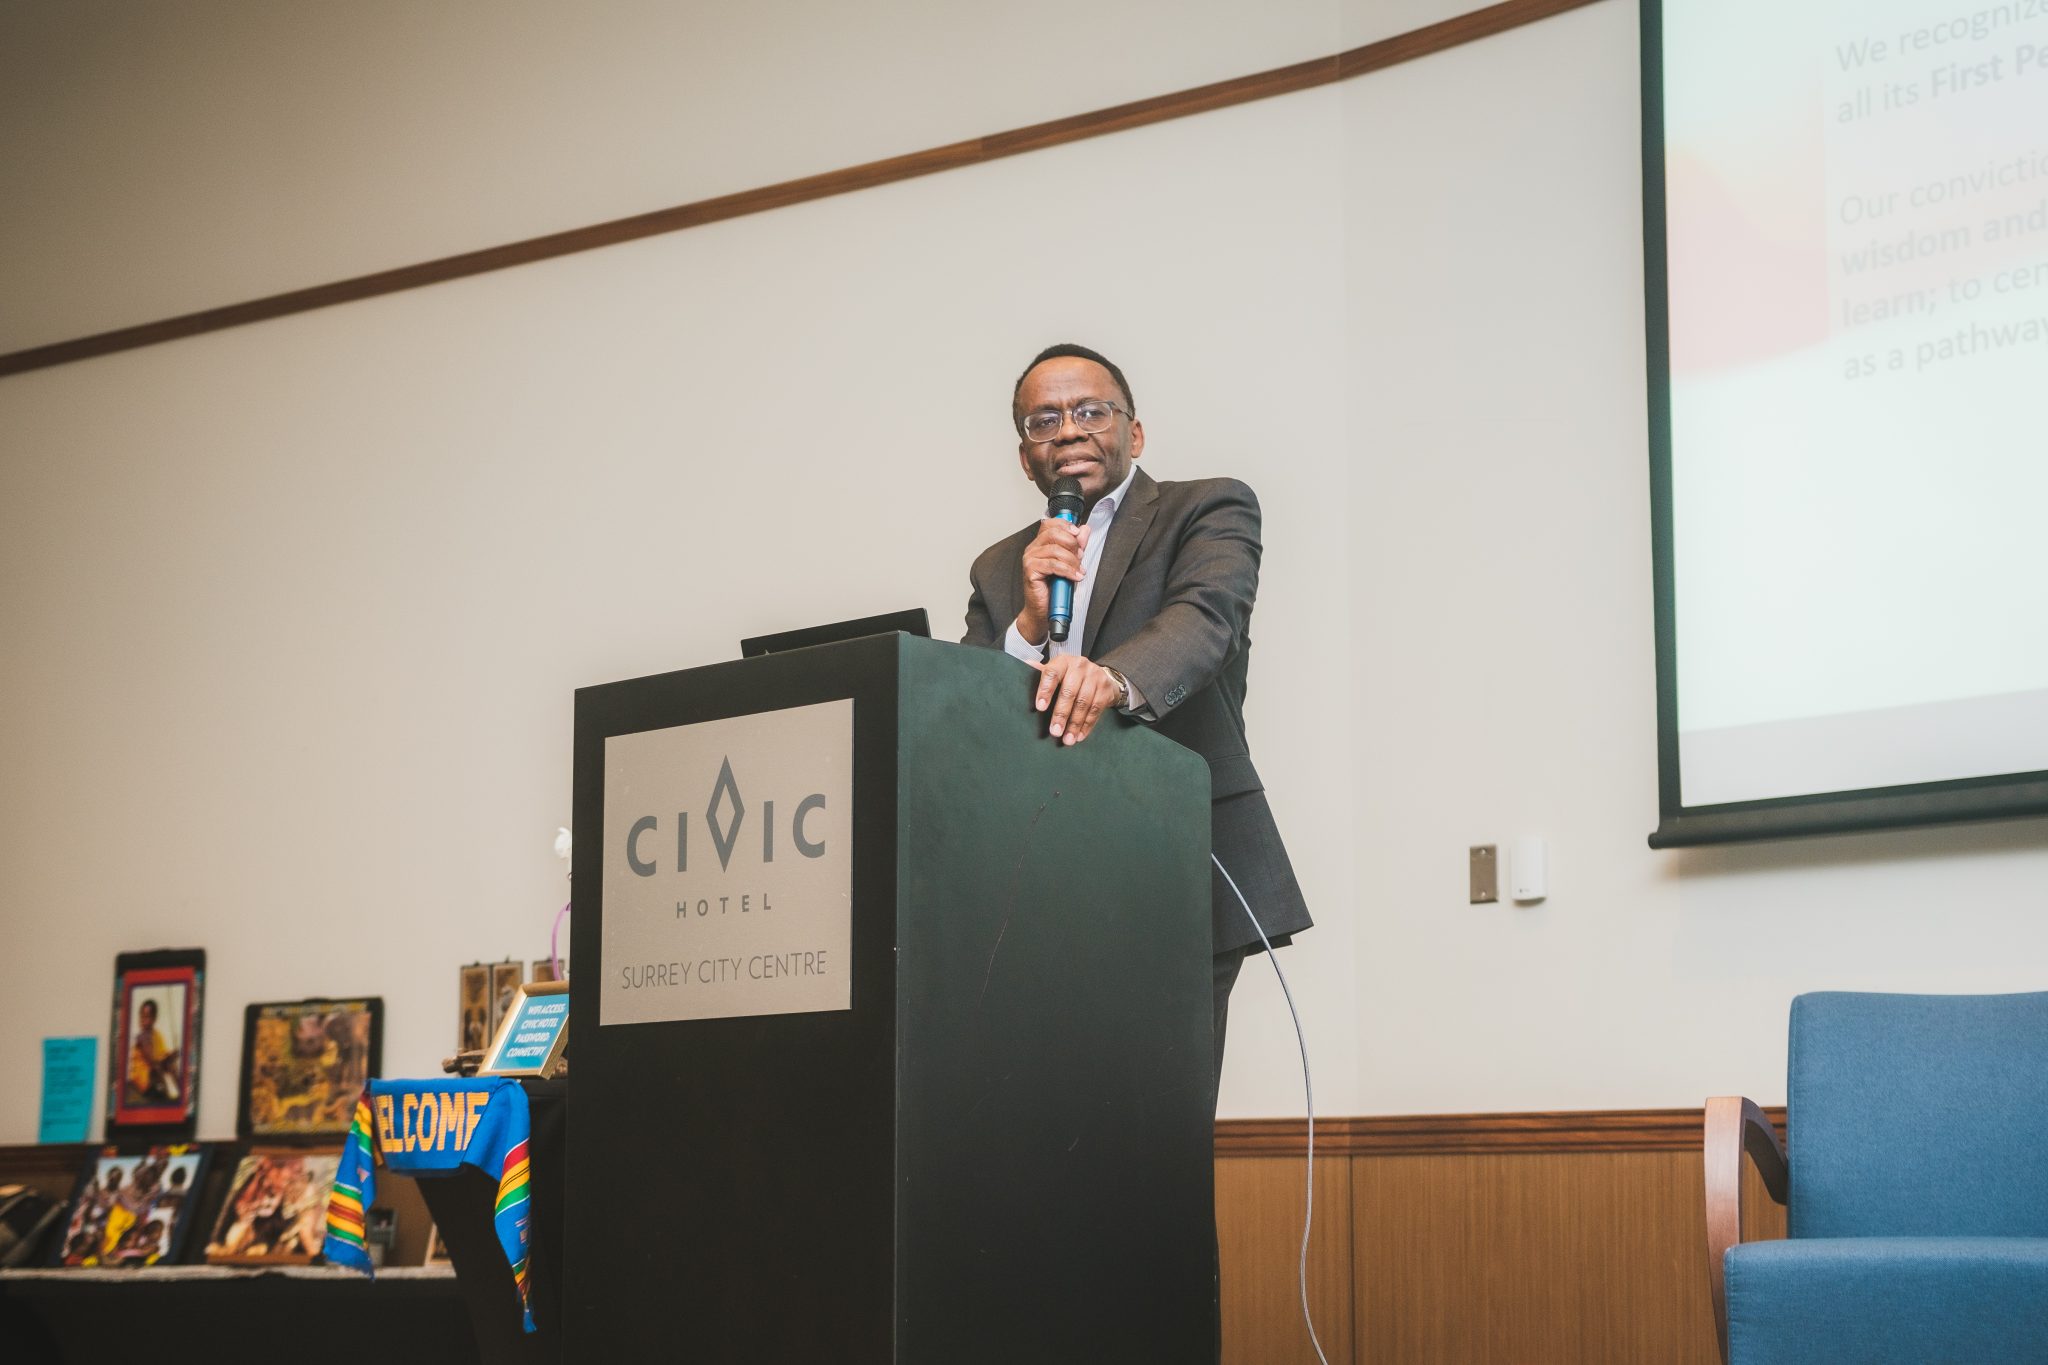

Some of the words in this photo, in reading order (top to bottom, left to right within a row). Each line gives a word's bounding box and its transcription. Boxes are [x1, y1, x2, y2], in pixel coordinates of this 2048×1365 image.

[1836, 36, 1887, 72] We
[1837, 85, 1871, 123] all
[1883, 82, 1919, 111] its
[1931, 54, 2004, 98] First
[1840, 191, 1899, 225] Our
[1841, 229, 1971, 276] wisdom
[1983, 198, 2048, 243] and
[1842, 289, 1936, 328] learn;
[1948, 278, 1981, 303] to
[1844, 353, 1877, 381] as
[1888, 348, 1904, 371] a
[626, 754, 826, 877] CIVIC
[676, 893, 771, 918] HOTEL
[622, 961, 692, 989] SURREY
[698, 958, 742, 983] CITY
[749, 951, 827, 980] CENTRE
[374, 1092, 489, 1152] ELCOME
